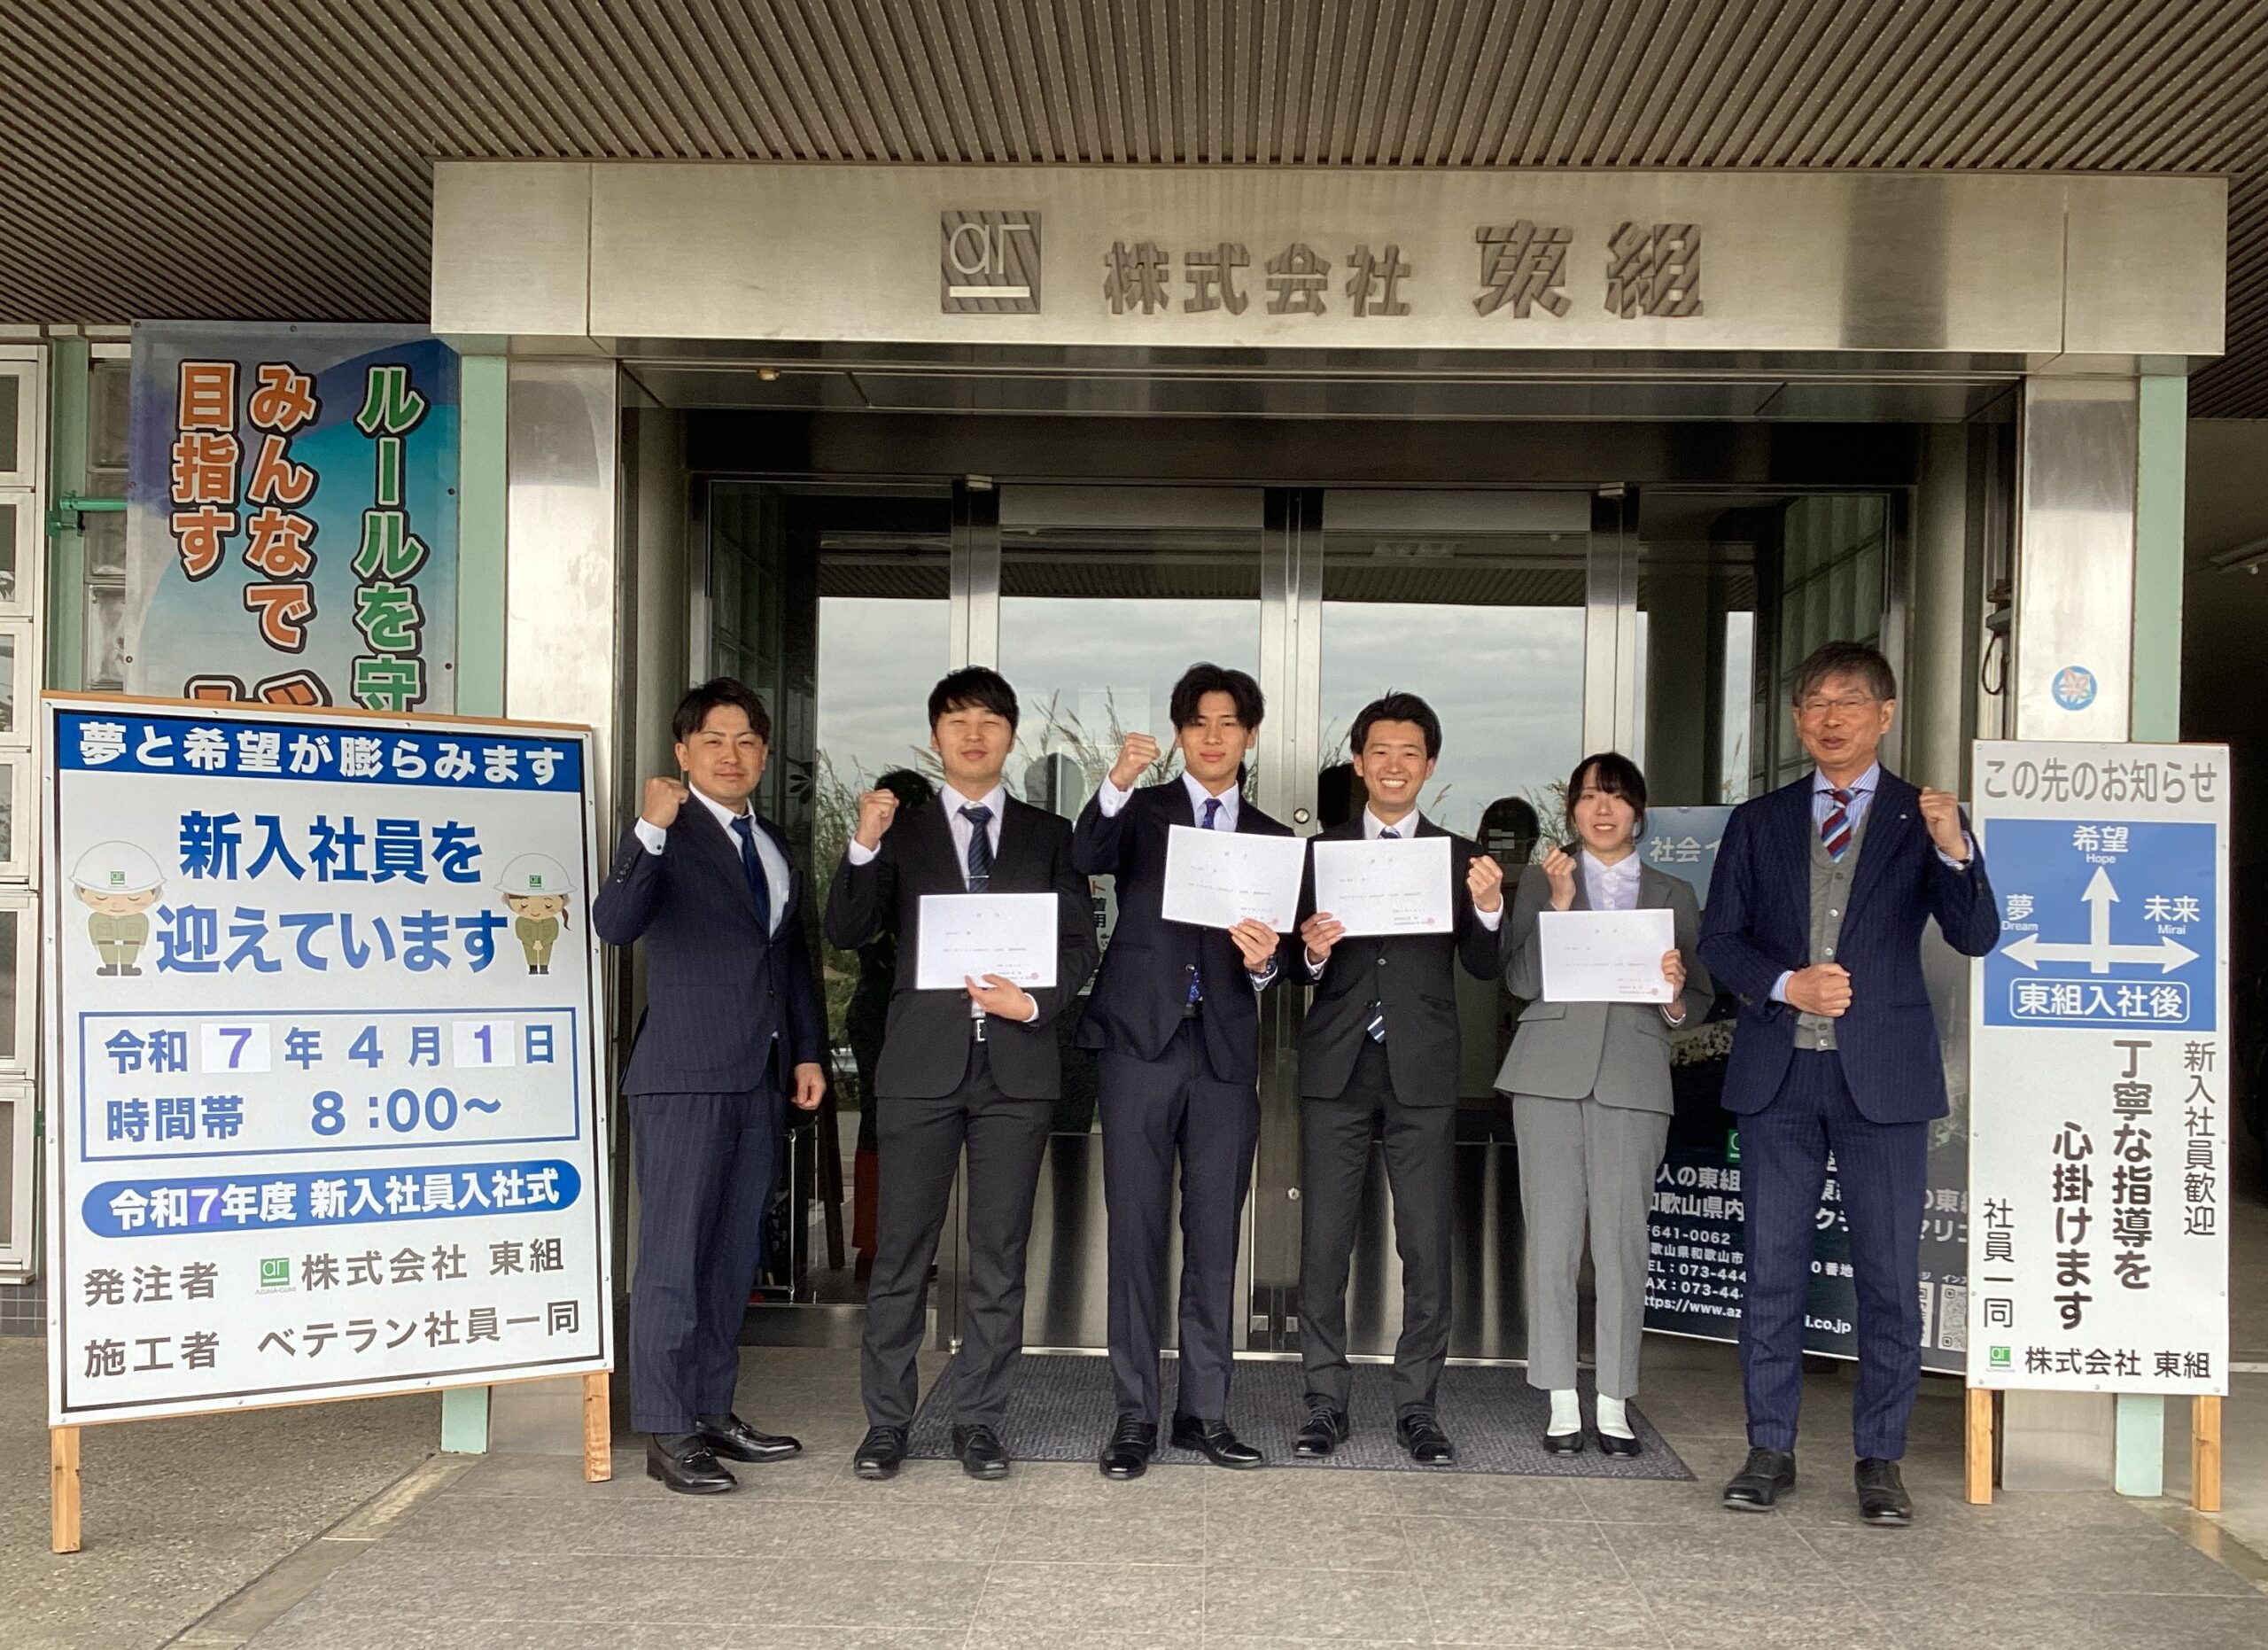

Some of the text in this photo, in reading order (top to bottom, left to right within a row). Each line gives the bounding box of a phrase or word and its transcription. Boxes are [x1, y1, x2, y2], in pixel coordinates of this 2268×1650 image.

[1104, 221, 1704, 319] 株式会社 東組
[171, 361, 239, 578] 目指す
[245, 363, 317, 650] みんなで
[80, 721, 564, 783] 夢と希望が膨らみます
[1984, 757, 2218, 804] この先のお知らせ
[179, 809, 483, 883] 新入社員を
[2072, 825, 2129, 852] 希望
[2085, 853, 2116, 865] Hope
[155, 905, 509, 974] 迎えています
[2001, 921, 2039, 931] Dream
[2006, 894, 2034, 921] 夢
[2144, 895, 2201, 922] 未来
[2157, 923, 2186, 935] Mirai
[2017, 984, 2183, 1019] 東組入社後
[105, 1094, 244, 1142] 時間帯
[2183, 1040, 2216, 1237] 新入社員歓迎
[2112, 1039, 2153, 1289] 丁寧な指導を
[109, 1166, 560, 1231] 令和7年度 新入社員入社式
[2053, 1121, 2093, 1330] 心掛けます
[84, 1237, 565, 1307] 発注者 株式会社 東組
[1983, 1197, 2015, 1329] 社員一同
[84, 1299, 581, 1379] 施工者 ベテラン社員一同
[2024, 1346, 2212, 1379] 株式会社 東組
